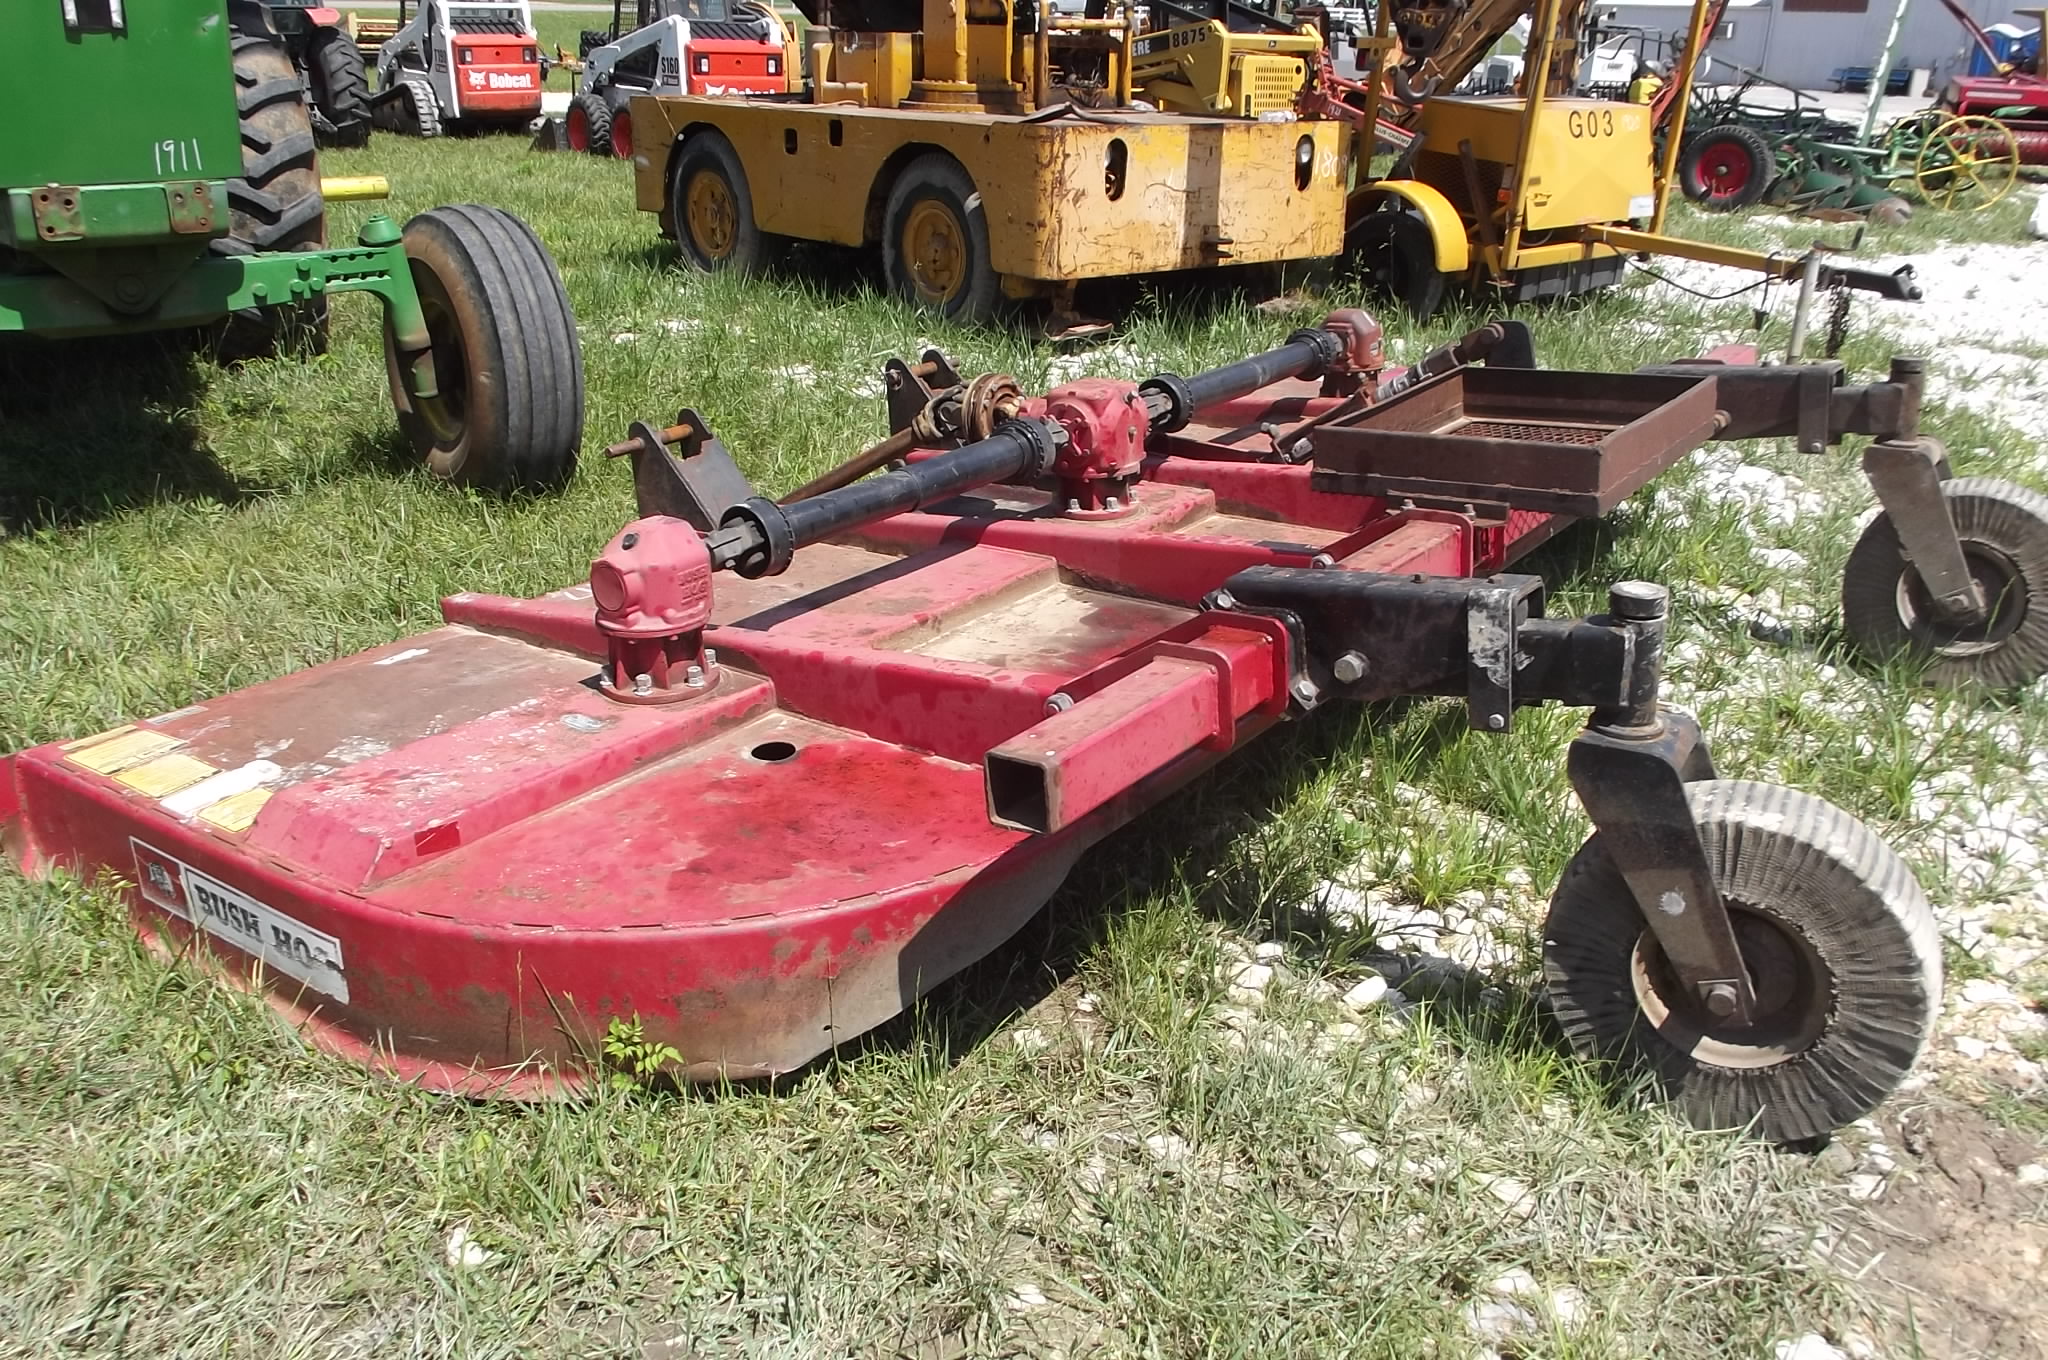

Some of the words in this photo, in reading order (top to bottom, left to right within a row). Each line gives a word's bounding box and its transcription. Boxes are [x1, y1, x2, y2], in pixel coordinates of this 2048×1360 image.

[1132, 39, 1150, 57] ERE
[1172, 26, 1206, 48] 8875
[661, 57, 679, 74] S160
[489, 73, 532, 89] Bobcat
[1569, 110, 1614, 138] G03
[155, 138, 202, 175] 1911
[194, 884, 266, 944] BUSH
